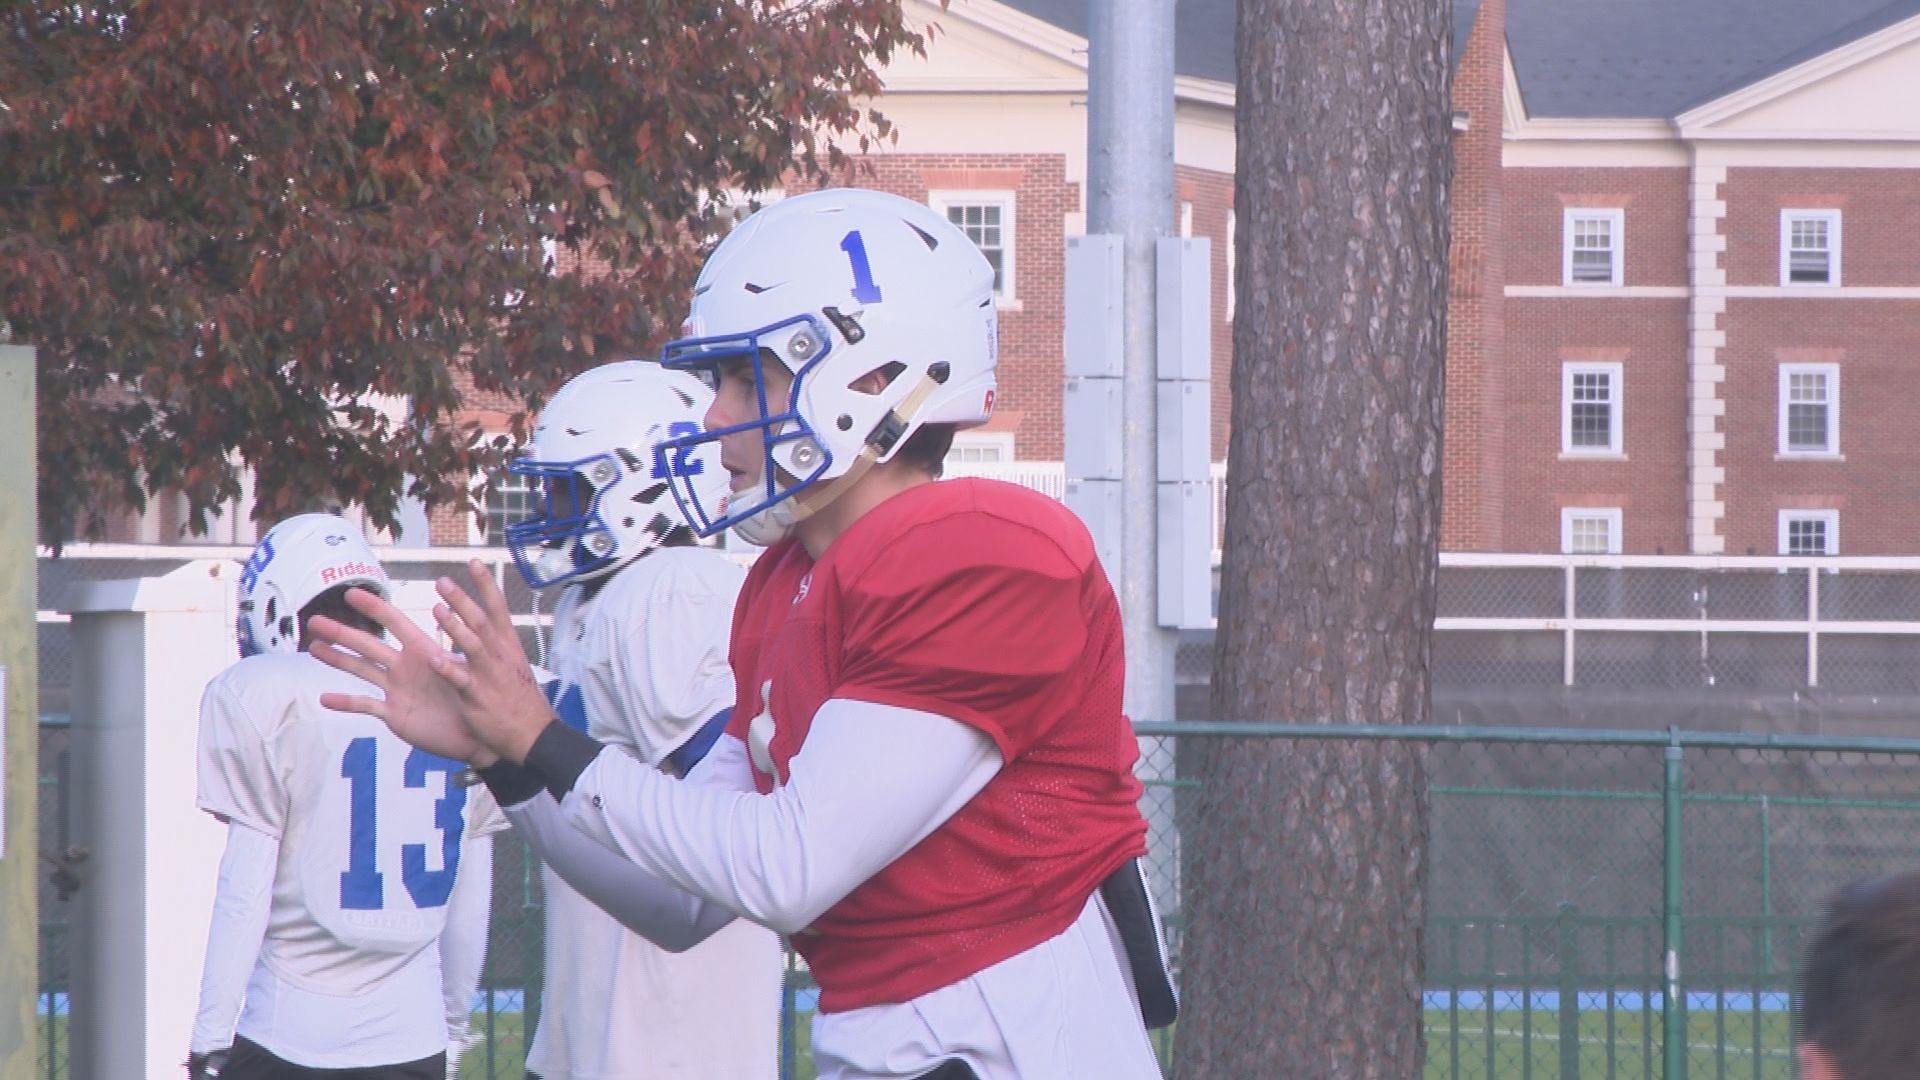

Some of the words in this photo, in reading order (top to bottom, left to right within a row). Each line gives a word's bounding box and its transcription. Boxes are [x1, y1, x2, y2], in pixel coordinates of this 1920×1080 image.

[840, 230, 882, 303] 1
[650, 421, 704, 479] 12
[339, 736, 468, 910] 13
